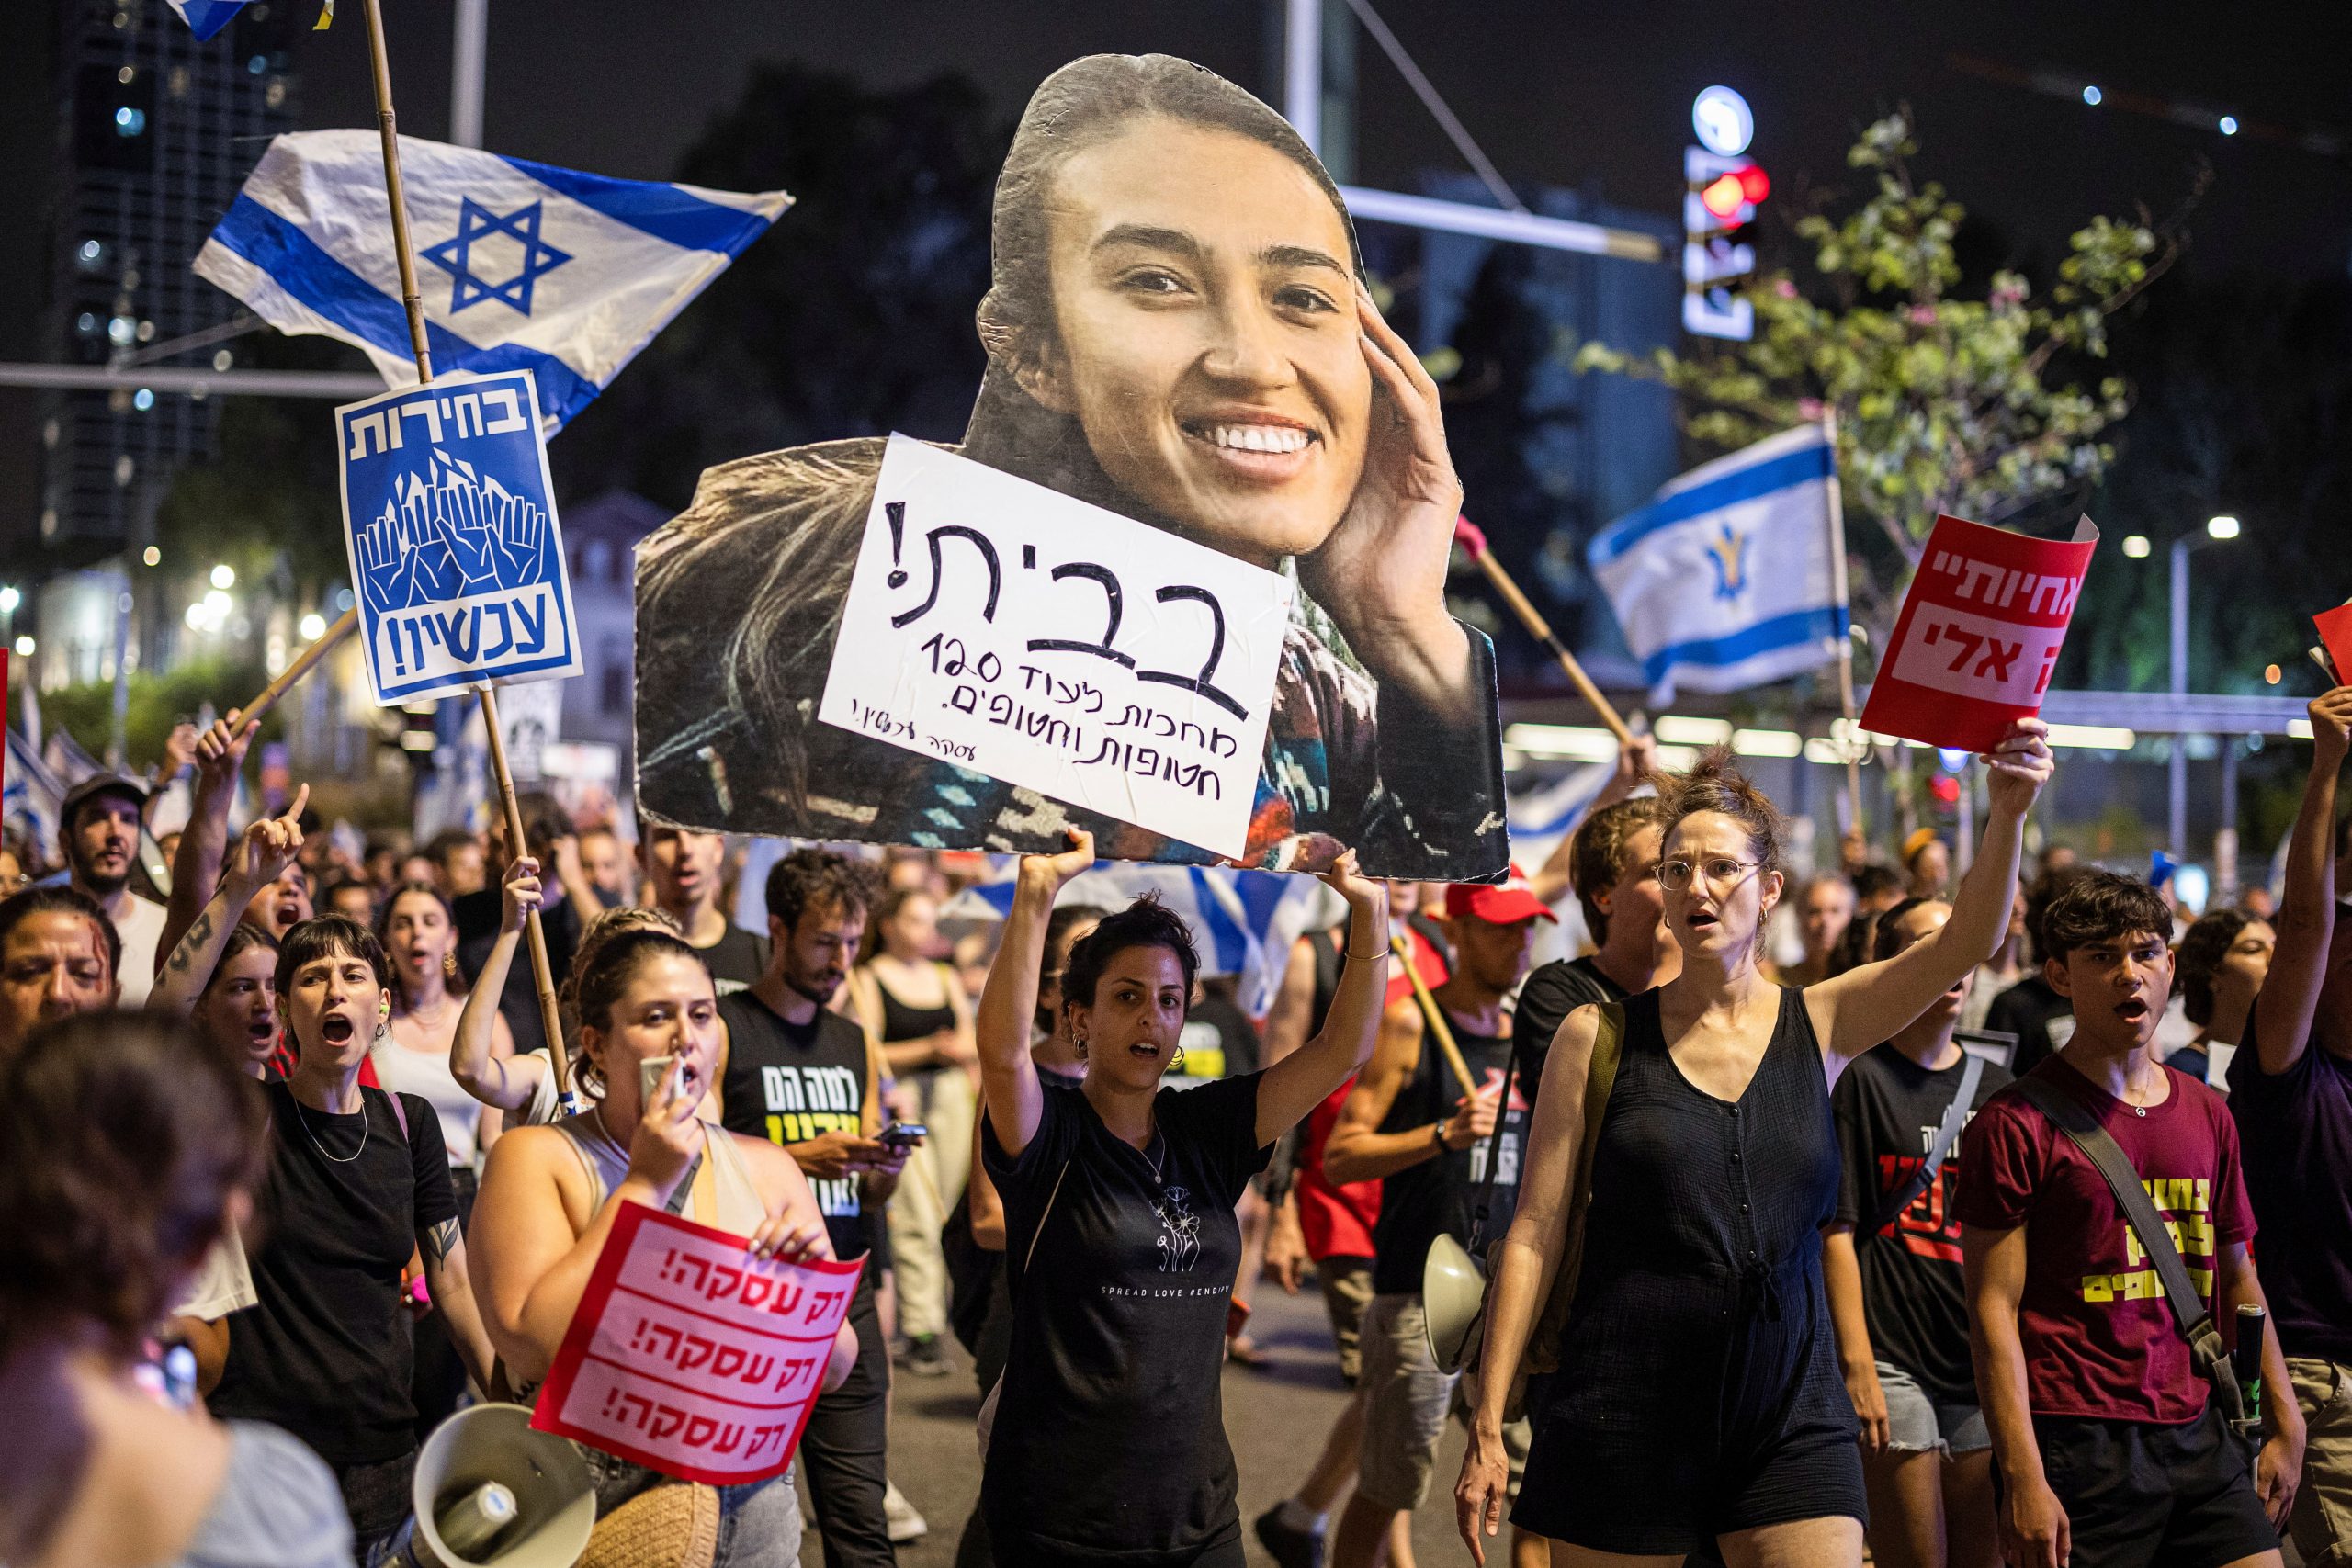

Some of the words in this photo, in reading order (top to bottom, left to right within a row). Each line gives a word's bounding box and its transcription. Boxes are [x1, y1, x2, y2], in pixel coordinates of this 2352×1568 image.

[350, 389, 527, 461] בחירות
[386, 593, 546, 676] עכשיו!
[885, 501, 1249, 722] בבית!
[921, 632, 1001, 682] 120
[1924, 624, 2022, 682] אלי
[1019, 665, 1102, 713] לעוד
[942, 685, 1081, 752] וחטופים.
[1104, 705, 1237, 758] מחכות
[926, 735, 976, 761] עסקה
[1072, 737, 1221, 800] חטופות
[762, 1066, 805, 1111] הם
[802, 1066, 860, 1111] למה
[658, 1248, 803, 1316] עסקה!
[804, 1291, 845, 1325] רק
[1102, 1286, 1147, 1297] SPREAD
[1154, 1289, 1182, 1297] LOVE
[630, 1318, 774, 1385] עסקה!
[775, 1357, 816, 1393] רק
[602, 1387, 744, 1455] עסקה!
[744, 1423, 786, 1460] רק
